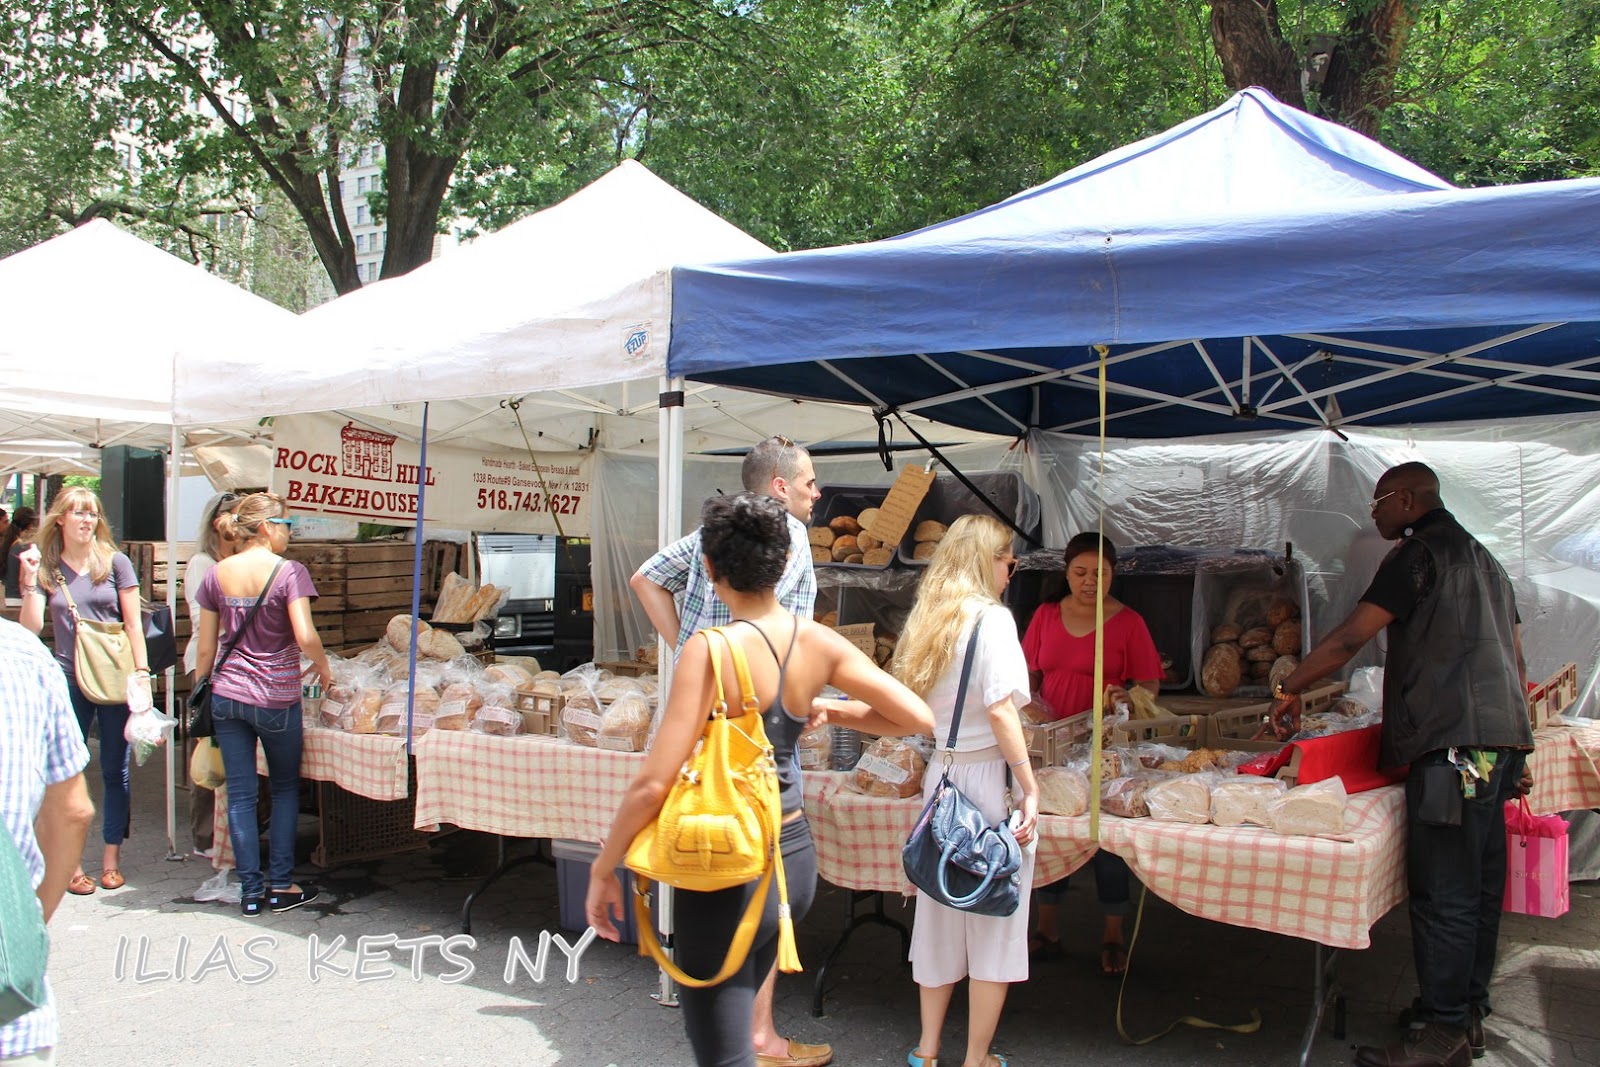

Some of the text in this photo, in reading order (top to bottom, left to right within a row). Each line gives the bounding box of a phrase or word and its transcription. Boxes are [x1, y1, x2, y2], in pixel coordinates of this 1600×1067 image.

[275, 447, 435, 486] ROCK HILL
[482, 457, 502, 468] Handmade
[473, 473, 486, 483] 1338
[557, 481, 570, 491] Yrk
[287, 480, 419, 513] BAKEHOUSE
[477, 488, 581, 515] 518.743.1627
